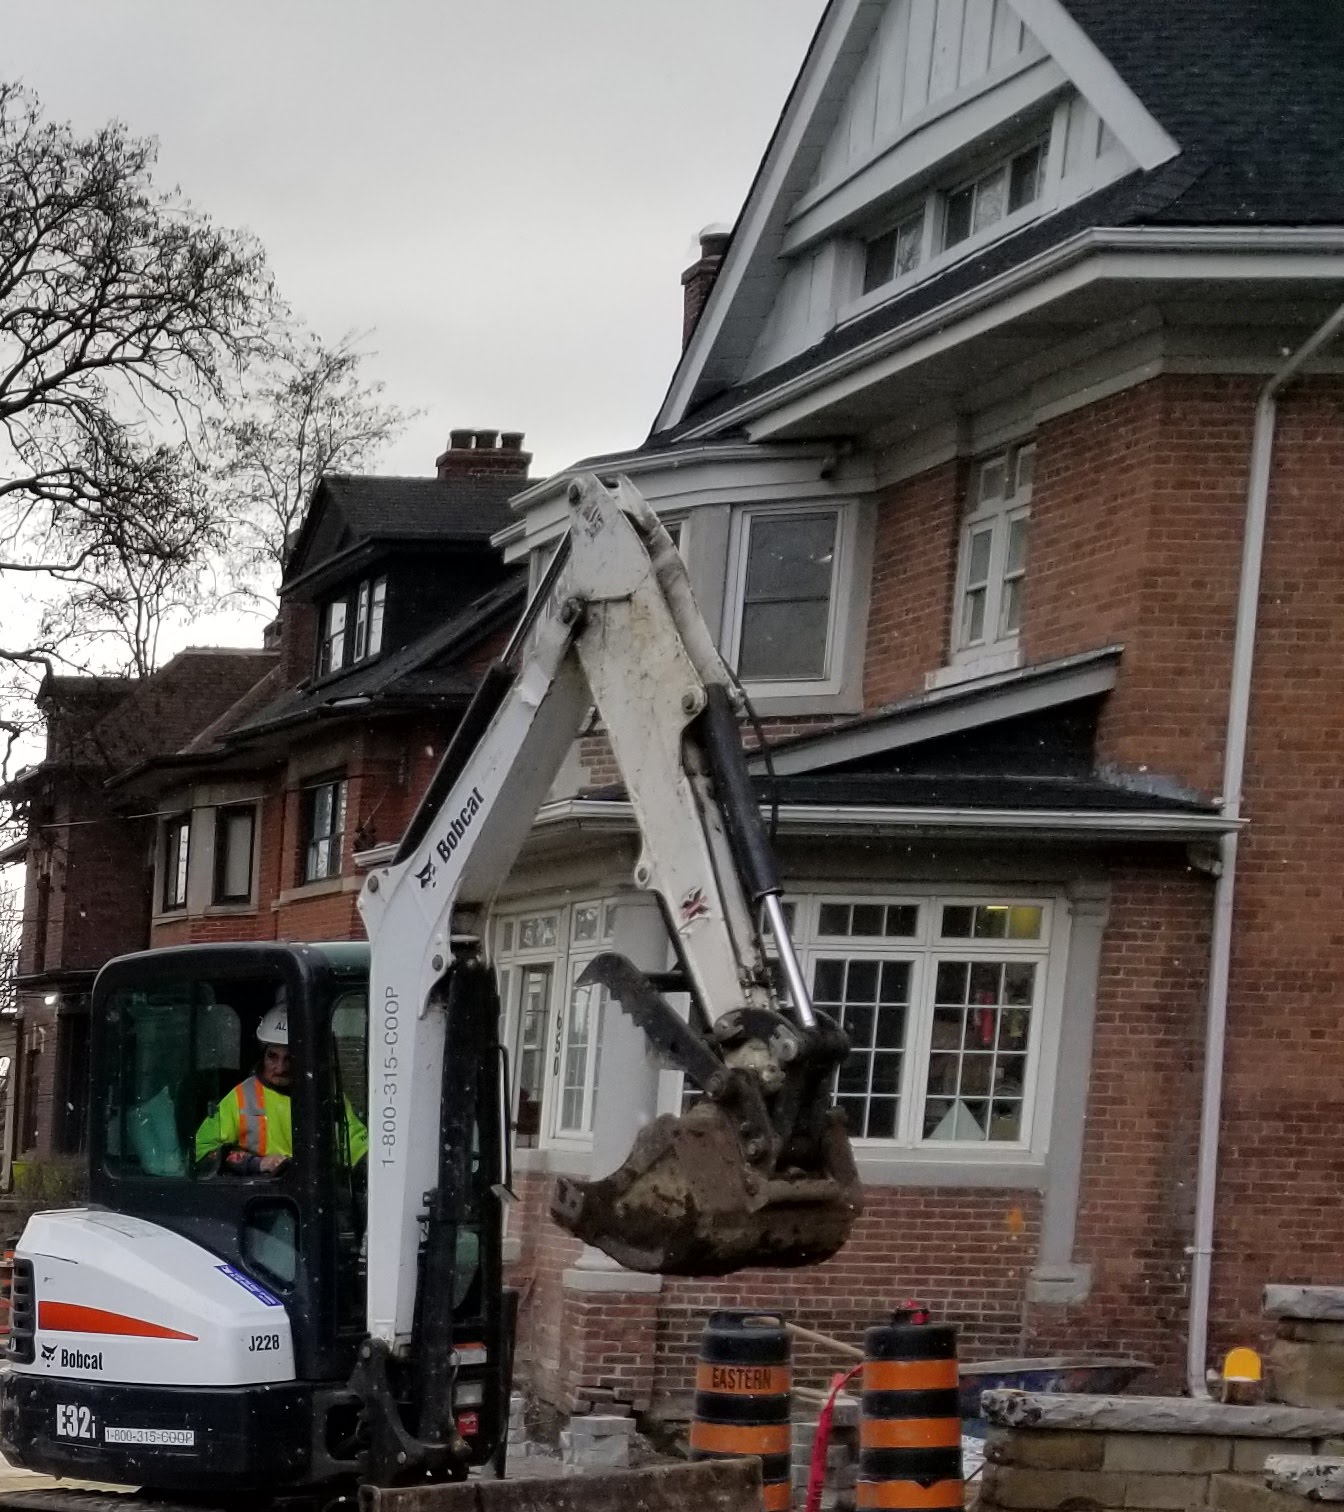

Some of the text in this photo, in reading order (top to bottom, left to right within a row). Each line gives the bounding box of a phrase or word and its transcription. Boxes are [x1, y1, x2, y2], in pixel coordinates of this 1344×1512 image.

[436, 786, 485, 864] Bobcat
[381, 985, 400, 1168] 1-800-315-COOP
[248, 1333, 280, 1352] J228
[60, 1348, 103, 1371] Bobcat
[712, 1367, 771, 1390] EASTERN
[56, 1403, 97, 1439] E32i
[105, 1429, 193, 1445] 1-800-315-COOP
